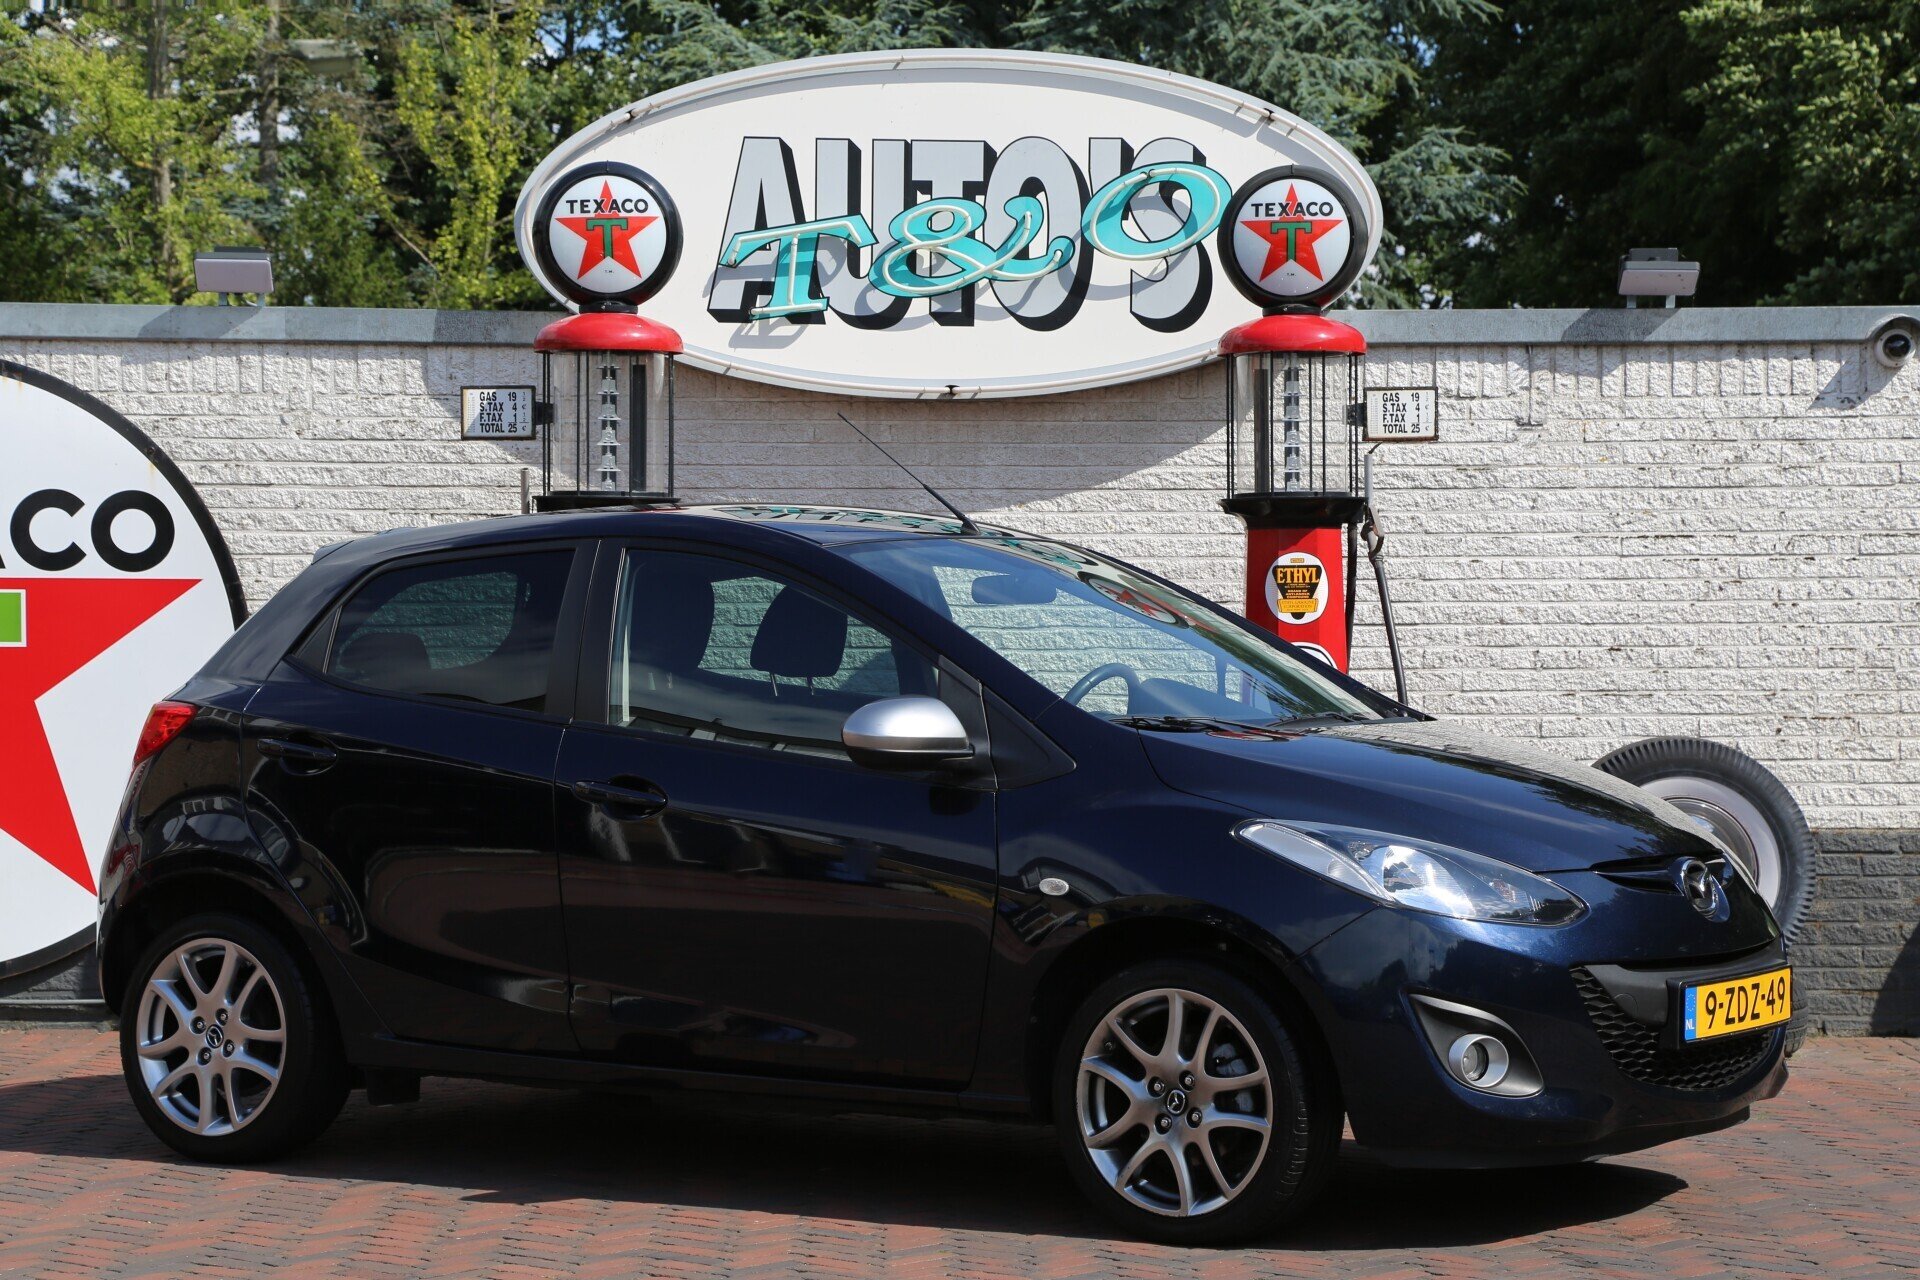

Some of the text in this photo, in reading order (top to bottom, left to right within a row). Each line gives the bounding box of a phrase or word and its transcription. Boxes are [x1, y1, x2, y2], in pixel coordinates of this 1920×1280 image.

[566, 199, 648, 214] TEXACO
[1251, 202, 1333, 217] TEXACO
[586, 218, 628, 259] T
[707, 136, 1213, 332] AUTO'S
[1270, 221, 1312, 262] T
[480, 392, 497, 401] GAS
[508, 392, 517, 401] 19
[1382, 393, 1400, 402] GAS
[1411, 393, 1420, 402] 19
[480, 402, 504, 412] S.TAX
[512, 403, 517, 412] 4
[1382, 403, 1407, 412] S.TAX
[1415, 403, 1420, 412] 4
[480, 413, 503, 422] F.TAX
[513, 413, 517, 422] 1
[1382, 413, 1406, 423] F.TAX
[1416, 414, 1420, 423] 1
[480, 423, 505, 433] TOTAL
[508, 423, 517, 433] 25
[1383, 424, 1408, 433] TOTAL
[1411, 424, 1420, 433] 25
[0, 488, 175, 572] CO
[1276, 567, 1320, 583] ETHYL
[1705, 976, 1786, 1029] 9-ZDZ-49
[1685, 1019, 1695, 1030] NL
